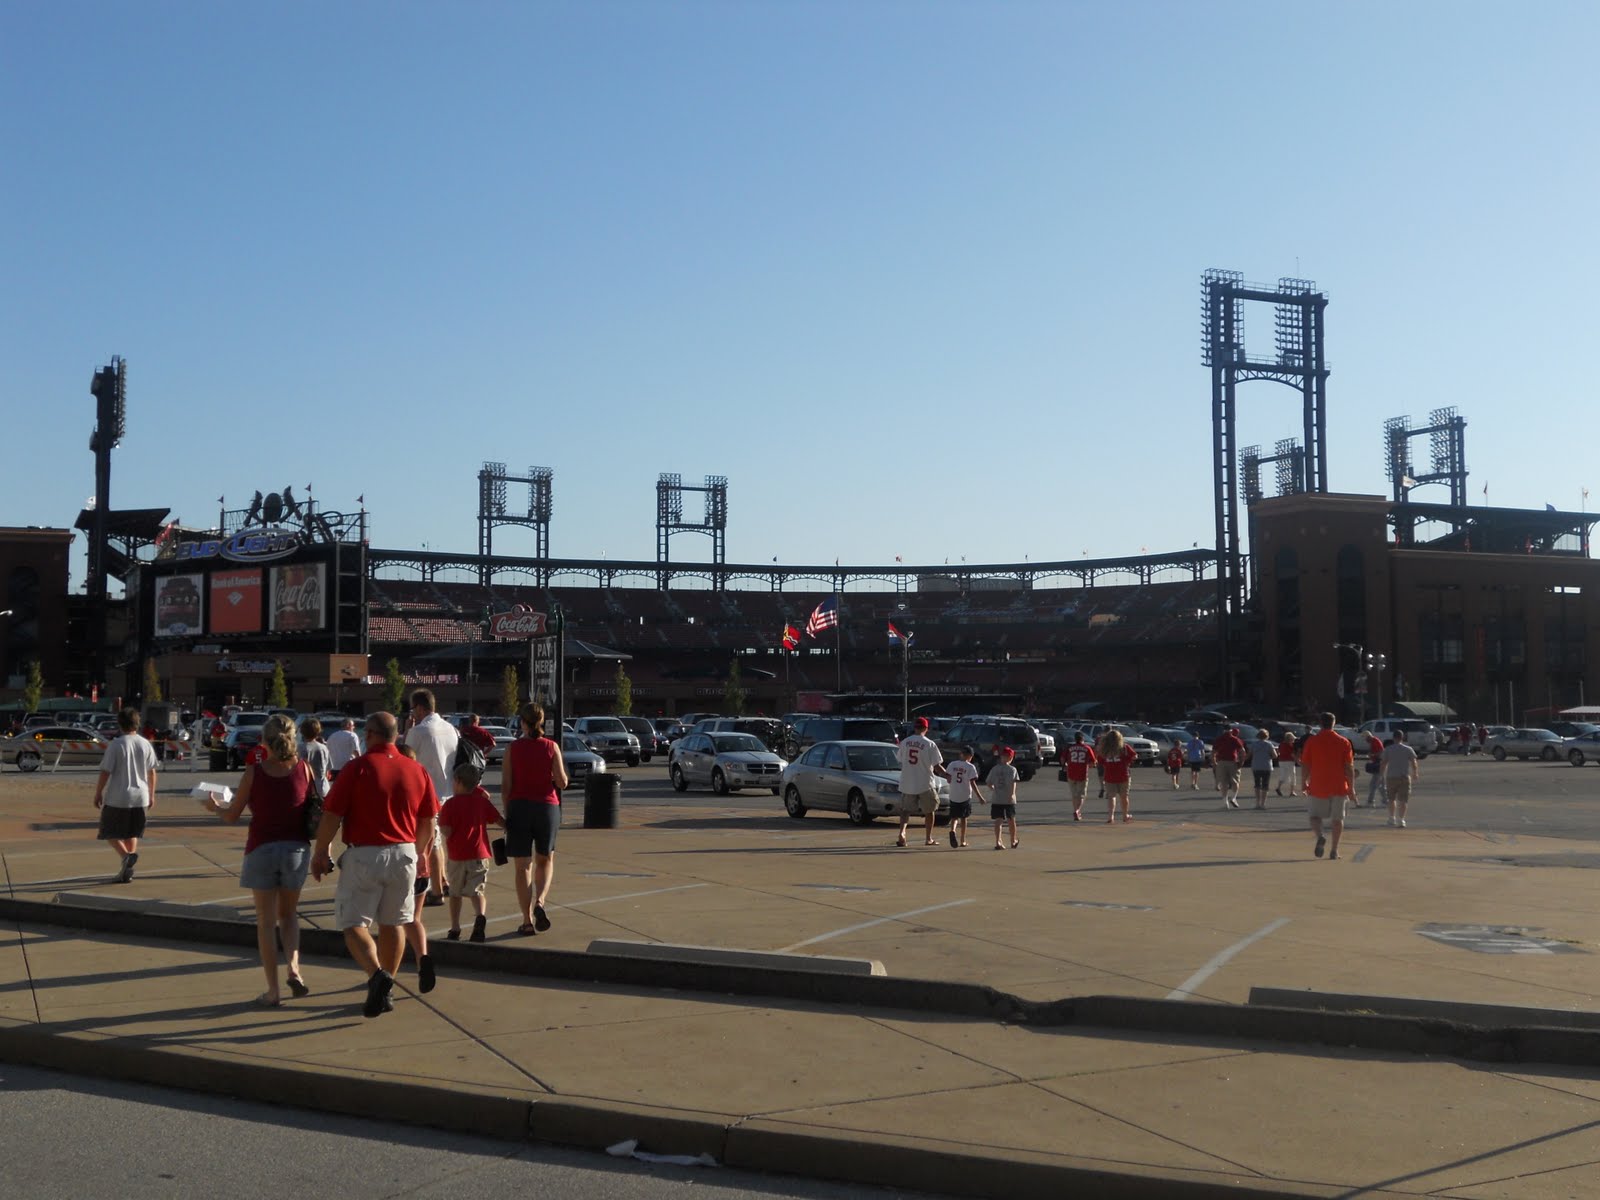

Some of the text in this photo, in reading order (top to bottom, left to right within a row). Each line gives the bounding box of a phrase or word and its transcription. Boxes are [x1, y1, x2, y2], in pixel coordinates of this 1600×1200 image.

[177, 540, 220, 560] BUD
[537, 642, 552, 657] PAY
[535, 660, 554, 674] HERE
[909, 749, 918, 764] 5
[1070, 751, 1086, 763] 22
[956, 772, 962, 783] 5
